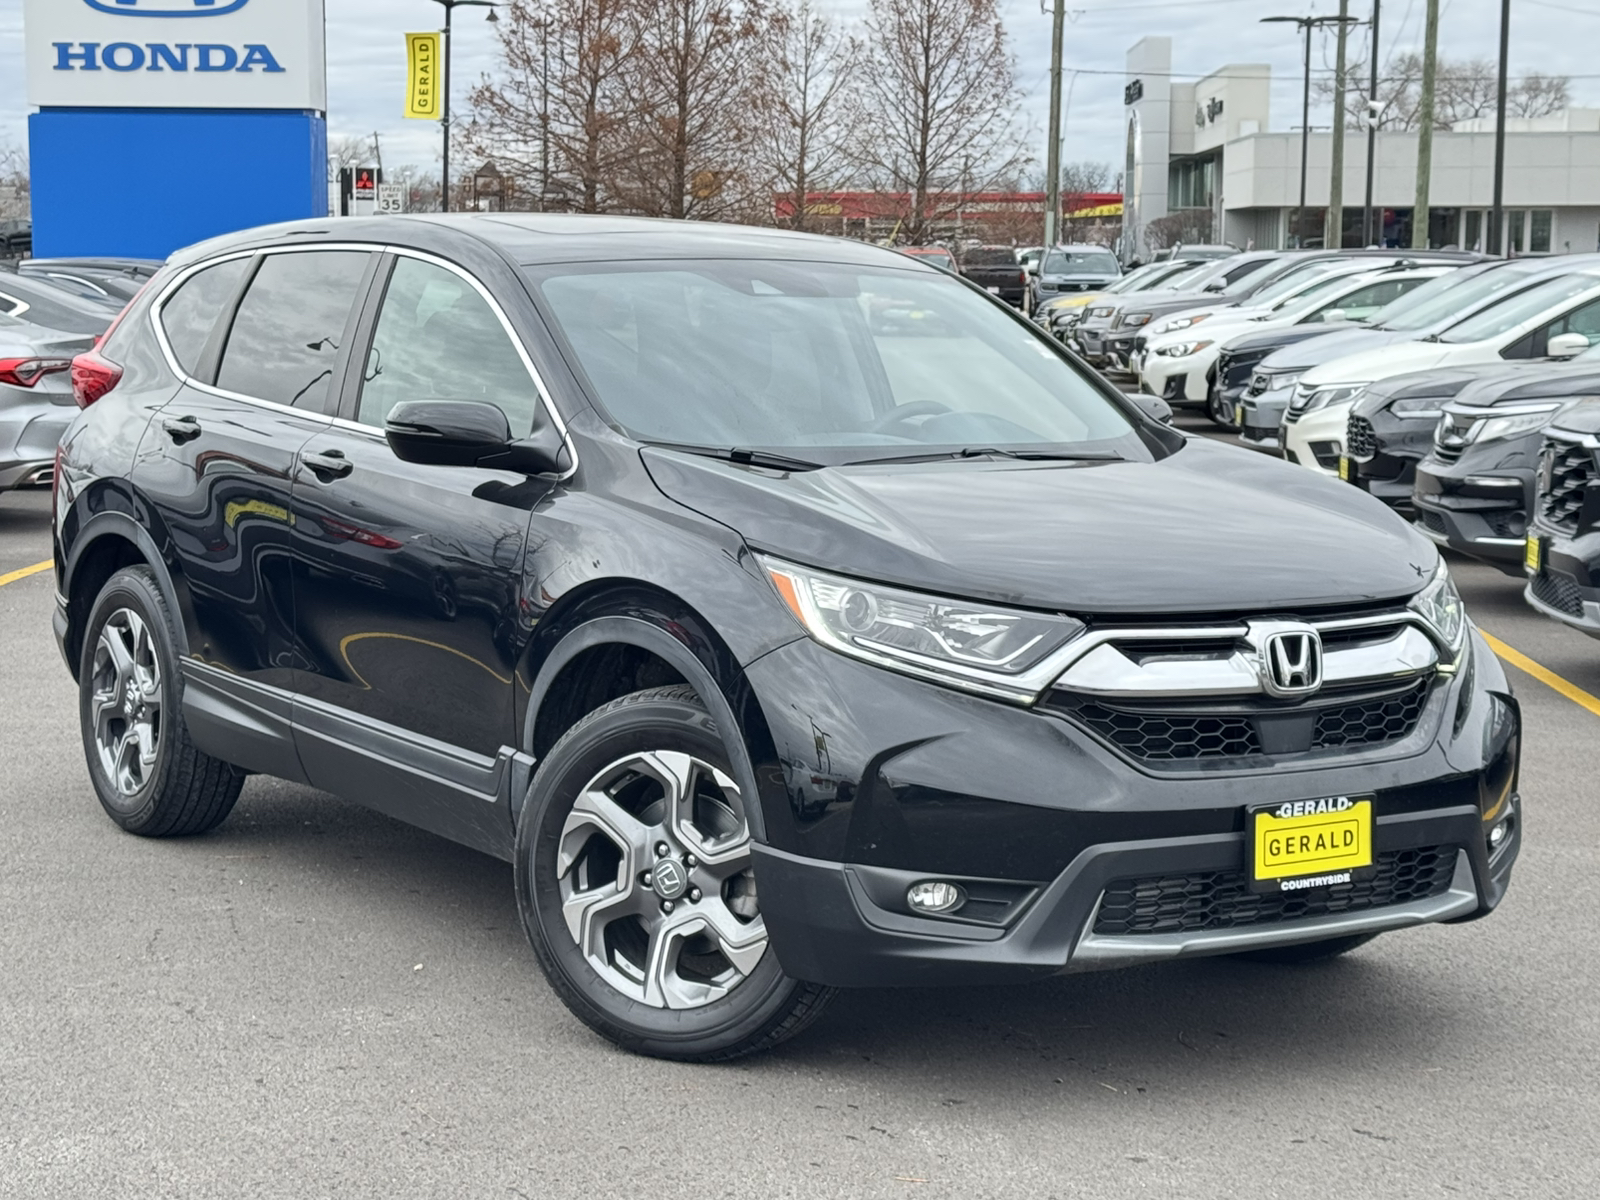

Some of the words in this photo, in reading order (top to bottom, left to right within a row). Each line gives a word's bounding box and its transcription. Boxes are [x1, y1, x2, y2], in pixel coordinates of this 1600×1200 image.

[52, 42, 286, 72] HONDA
[418, 43, 430, 107] GERALD
[381, 199, 401, 210] 35
[1280, 797, 1349, 818] GERALD
[1269, 830, 1354, 857] GERALD
[1281, 873, 1351, 891] COUNTRYSIDE
